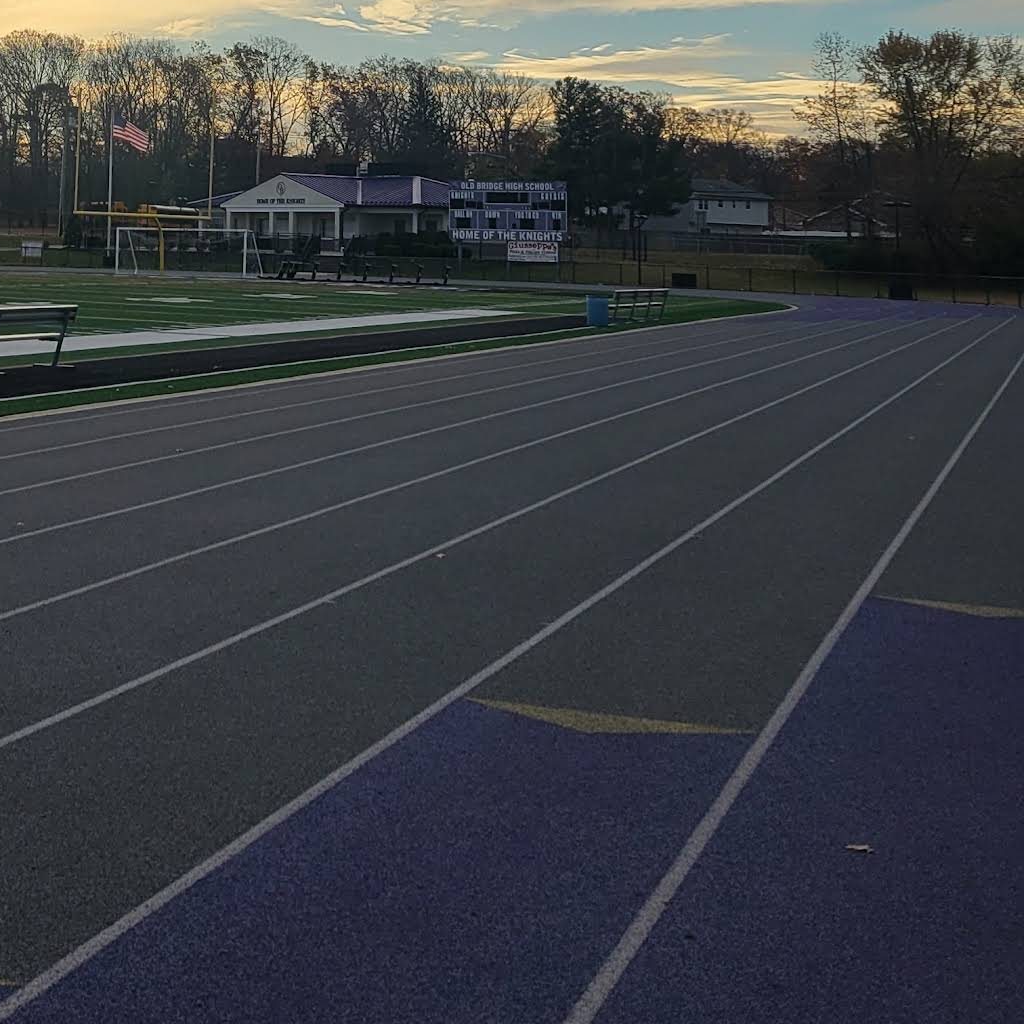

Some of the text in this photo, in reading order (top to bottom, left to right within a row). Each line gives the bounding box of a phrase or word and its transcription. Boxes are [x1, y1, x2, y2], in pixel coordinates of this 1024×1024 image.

[461, 182, 554, 191] OLD BRIDGE HIGH SCHOOL
[452, 230, 563, 241] HOME OF THE KNIGHTS
